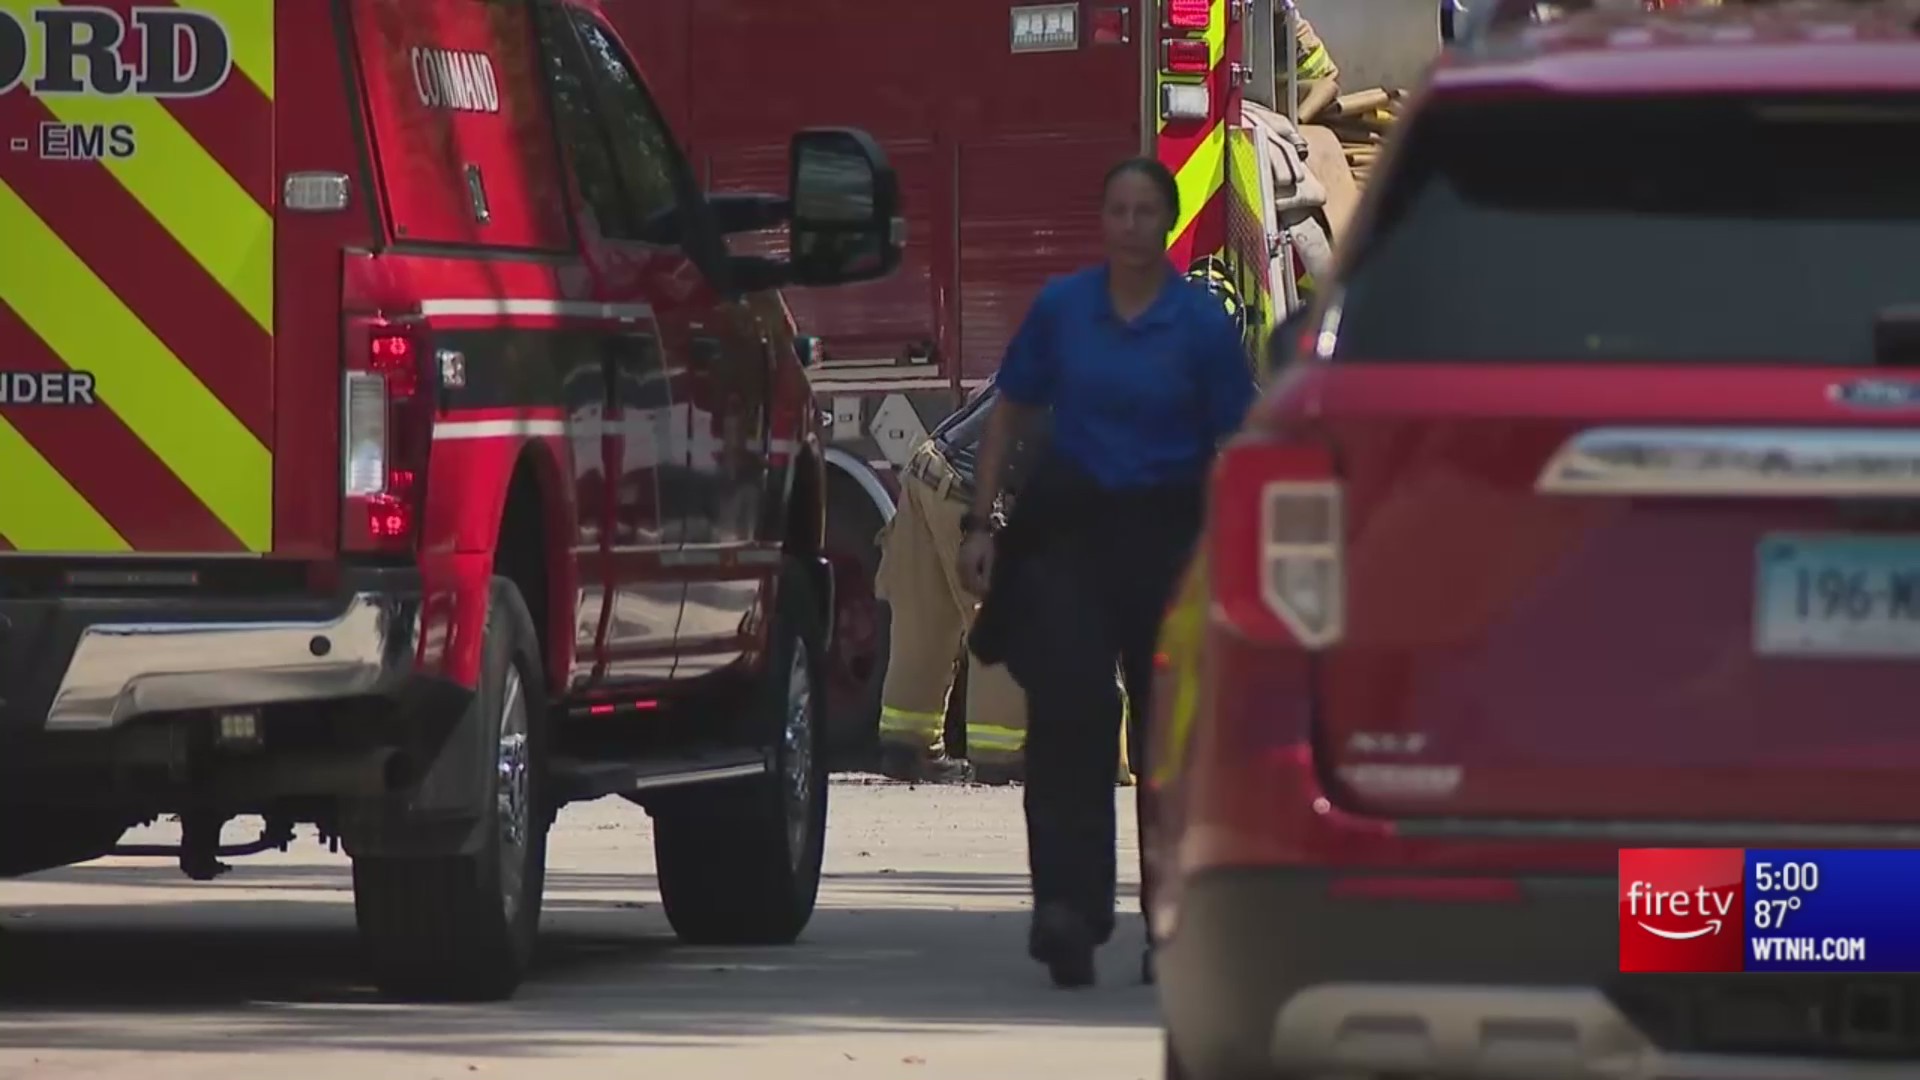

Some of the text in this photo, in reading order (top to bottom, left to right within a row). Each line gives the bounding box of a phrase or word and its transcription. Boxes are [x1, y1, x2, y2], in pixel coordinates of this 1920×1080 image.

[0, 6, 233, 98] RD
[411, 45, 499, 113] COMMAND
[40, 121, 136, 160] EMS
